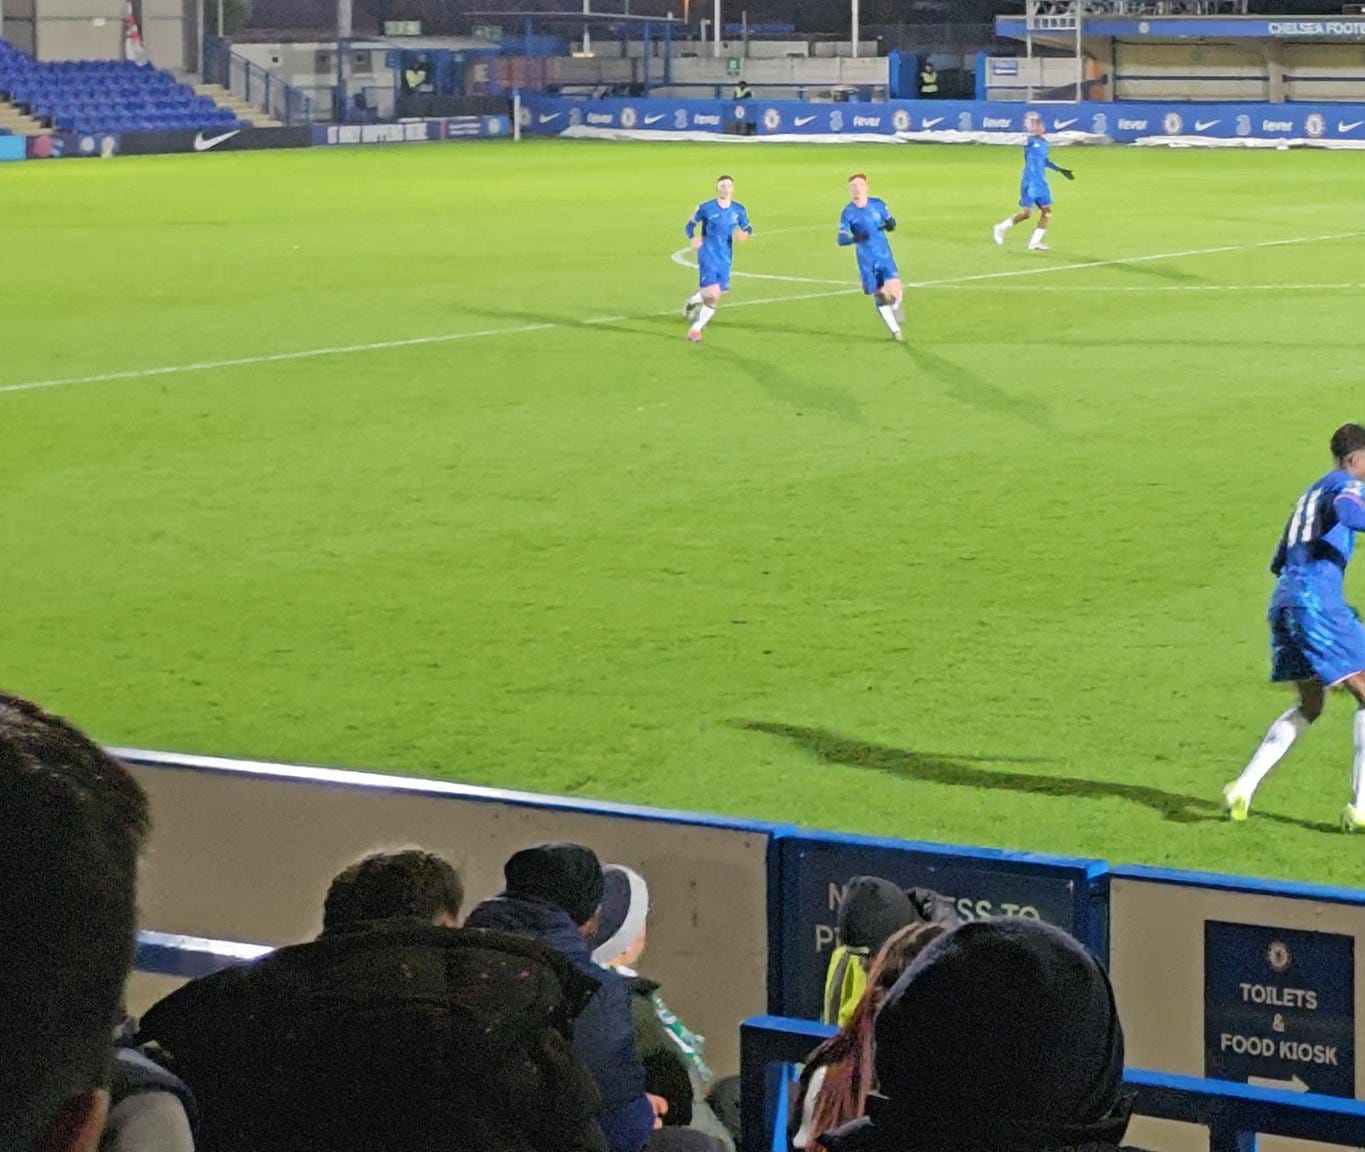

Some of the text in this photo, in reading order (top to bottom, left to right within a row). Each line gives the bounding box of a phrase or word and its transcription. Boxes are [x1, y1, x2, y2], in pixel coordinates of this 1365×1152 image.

[1268, 22, 1324, 35] CHELSEA
[1287, 486, 1323, 548] 11
[1239, 983, 1318, 1010] TOILETS
[1272, 1013, 1285, 1032] &
[1220, 1033, 1338, 1066] FOOD KIOSK
